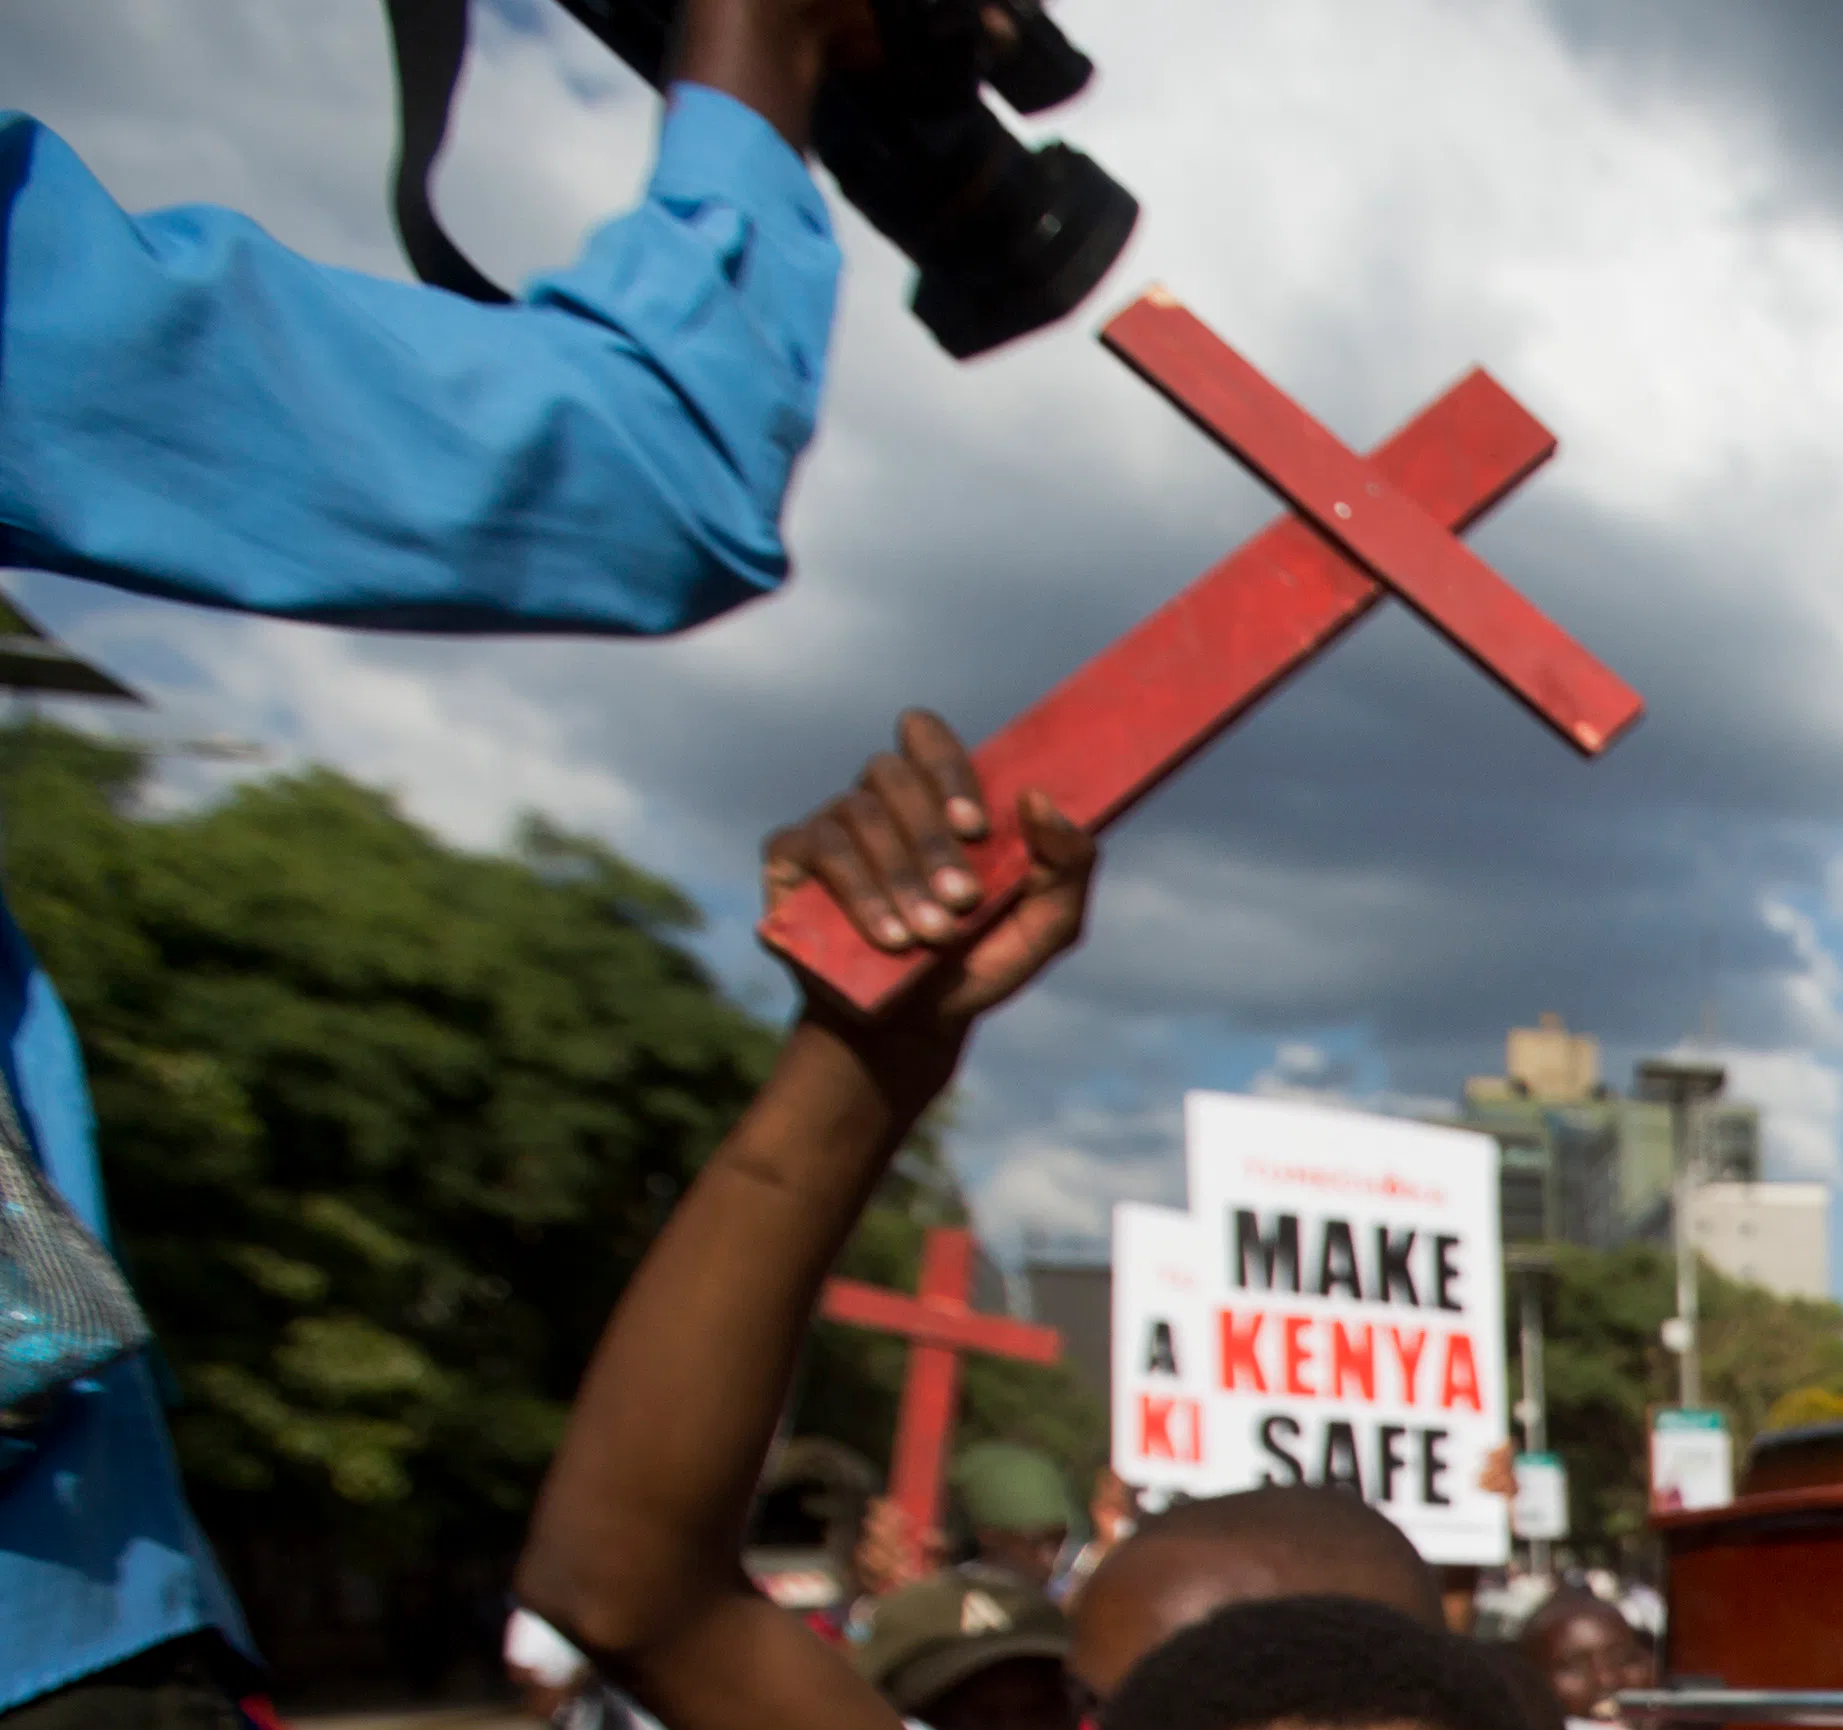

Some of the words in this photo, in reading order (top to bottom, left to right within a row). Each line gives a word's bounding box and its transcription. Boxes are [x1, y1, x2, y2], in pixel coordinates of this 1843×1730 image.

[1235, 1209, 1464, 1312] MAKE
[1147, 1321, 1177, 1375] A
[1220, 1309, 1483, 1413] KENYA
[1261, 1415, 1451, 1505] SAFE
